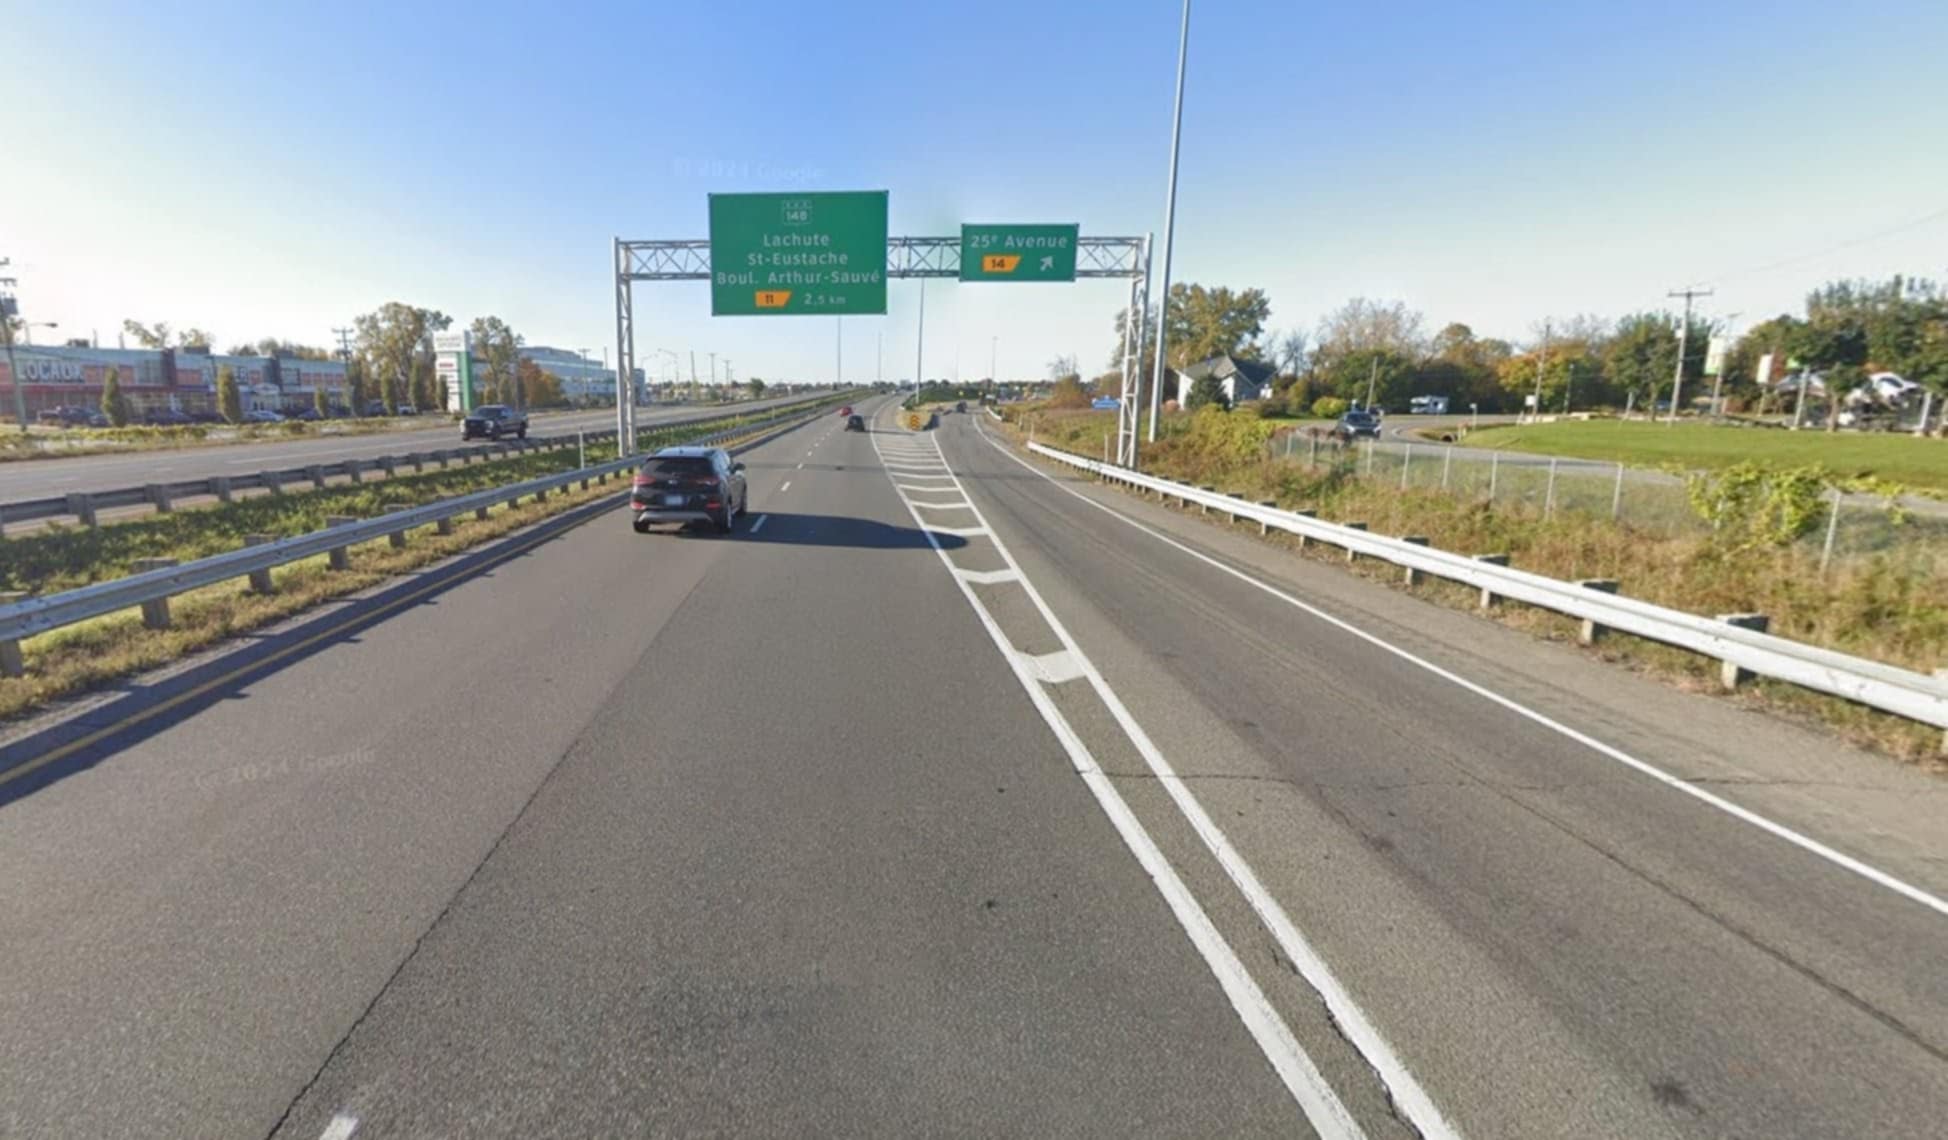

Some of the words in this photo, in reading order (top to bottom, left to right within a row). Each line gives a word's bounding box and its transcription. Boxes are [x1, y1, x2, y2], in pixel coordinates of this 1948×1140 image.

[786, 211, 808, 221] 148
[763, 233, 831, 247] Lachute
[1005, 234, 1068, 248] Avenue
[748, 252, 848, 266] St-Eustache
[991, 258, 1005, 269] 14
[717, 271, 759, 285] Boul.
[768, 269, 880, 285] Arthur-Sauvé
[765, 294, 775, 304] 11
[804, 294, 825, 306] 2,5
[829, 294, 846, 305] km
